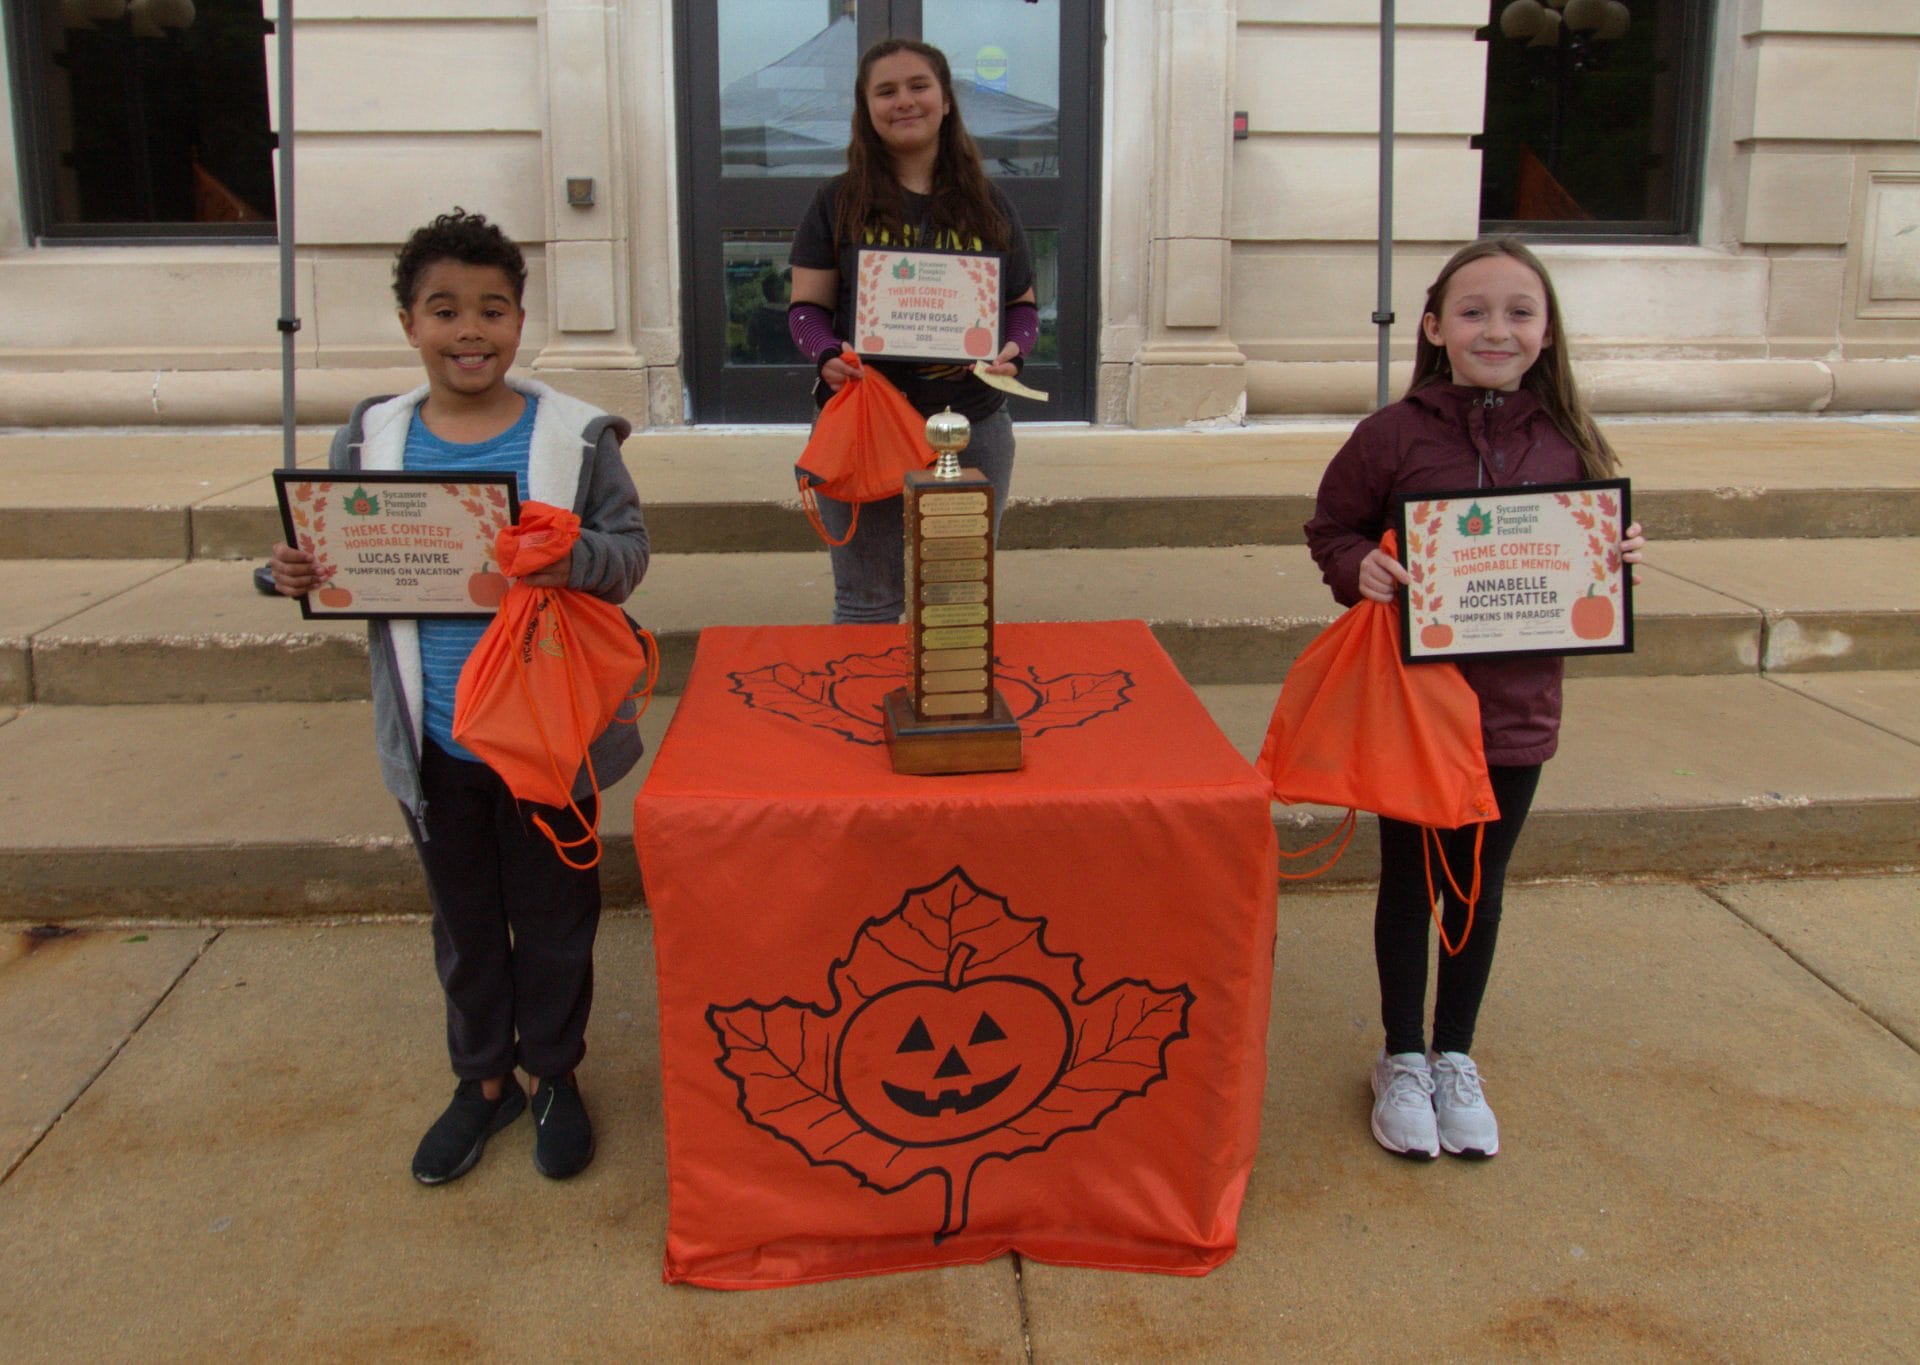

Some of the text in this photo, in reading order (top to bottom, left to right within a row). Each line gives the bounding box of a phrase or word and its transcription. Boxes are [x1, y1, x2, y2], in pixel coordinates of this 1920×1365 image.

[888, 286, 958, 299] THEME CONTEST
[898, 298, 945, 310] WINNER
[891, 311, 958, 323] RAYVEN ROSAS
[382, 490, 427, 501] Sycamore
[384, 499, 427, 510] Pumpkin
[1496, 504, 1540, 515] Sycamore
[385, 508, 422, 518] Festival
[1497, 514, 1539, 526] Pumpkin
[341, 523, 453, 539] THEME CONTEST
[1497, 525, 1532, 536] Festival
[345, 536, 464, 551] HONORABLE MENTION
[358, 552, 450, 564] LUCAS FAIVRE
[1452, 542, 1561, 563] THEME CONTEST
[399, 567, 412, 576] ON
[1453, 559, 1571, 577] HONORABLE MENTION
[395, 577, 419, 587] 2025
[1466, 576, 1548, 593] ANNABELLE
[1459, 591, 1558, 609] HOCHSTATTER
[1503, 610, 1514, 621] IN
